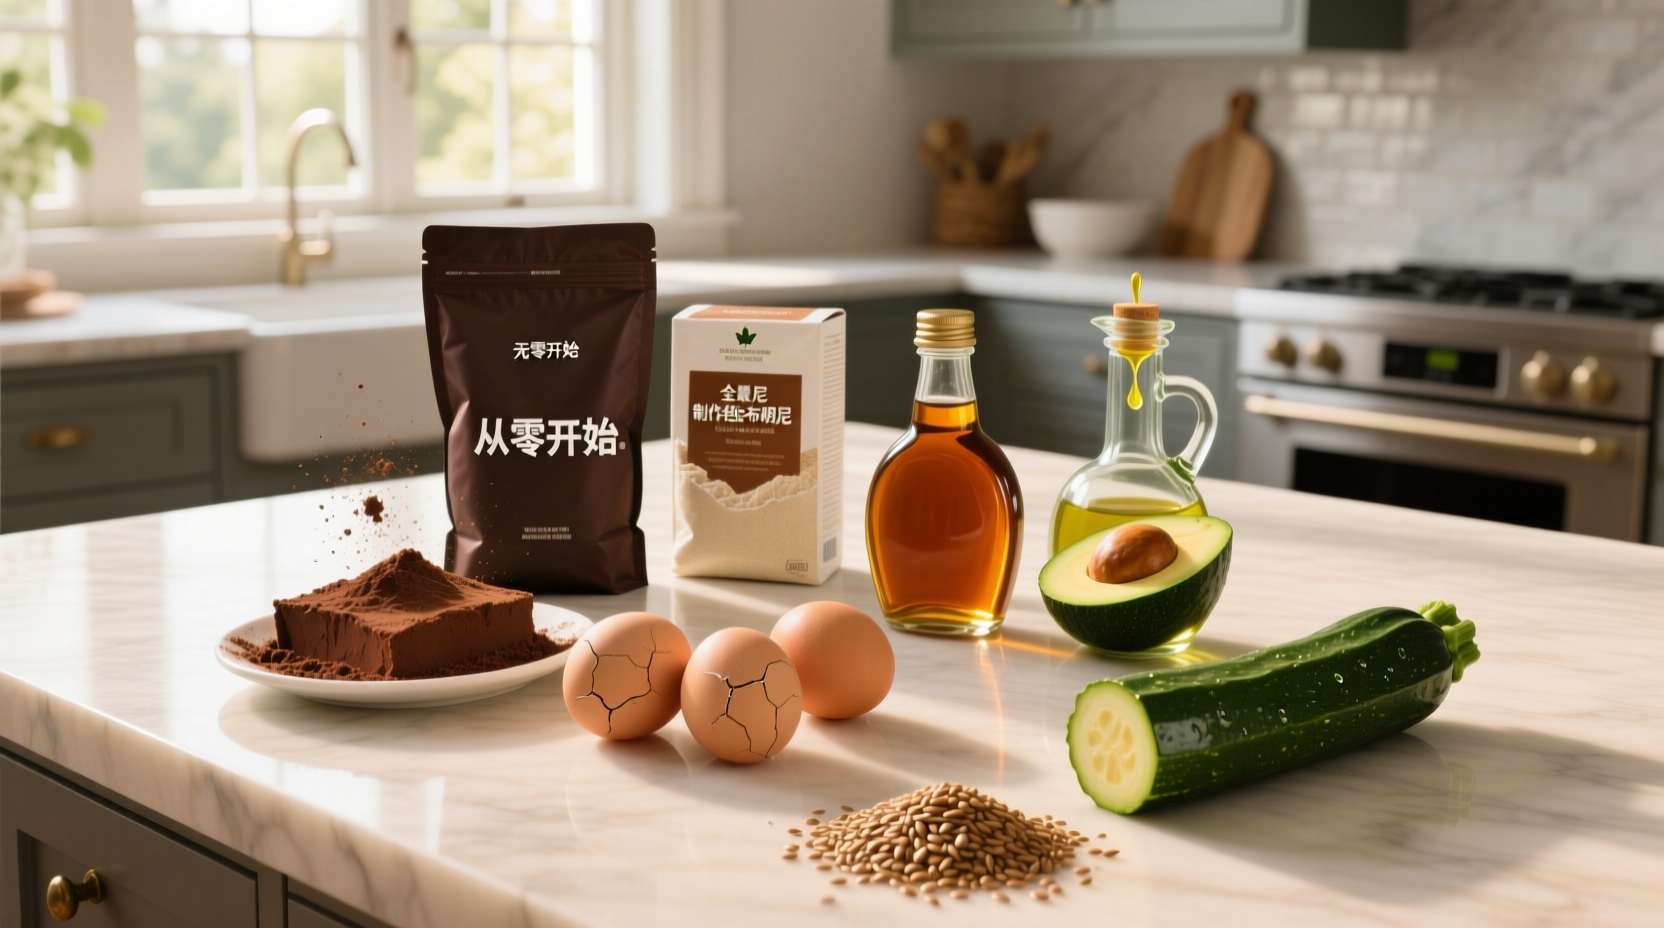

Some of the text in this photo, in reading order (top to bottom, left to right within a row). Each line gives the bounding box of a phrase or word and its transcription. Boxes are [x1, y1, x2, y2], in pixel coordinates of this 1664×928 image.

[513, 340, 580, 360] 无零开始
[473, 416, 619, 458] 从零开始
